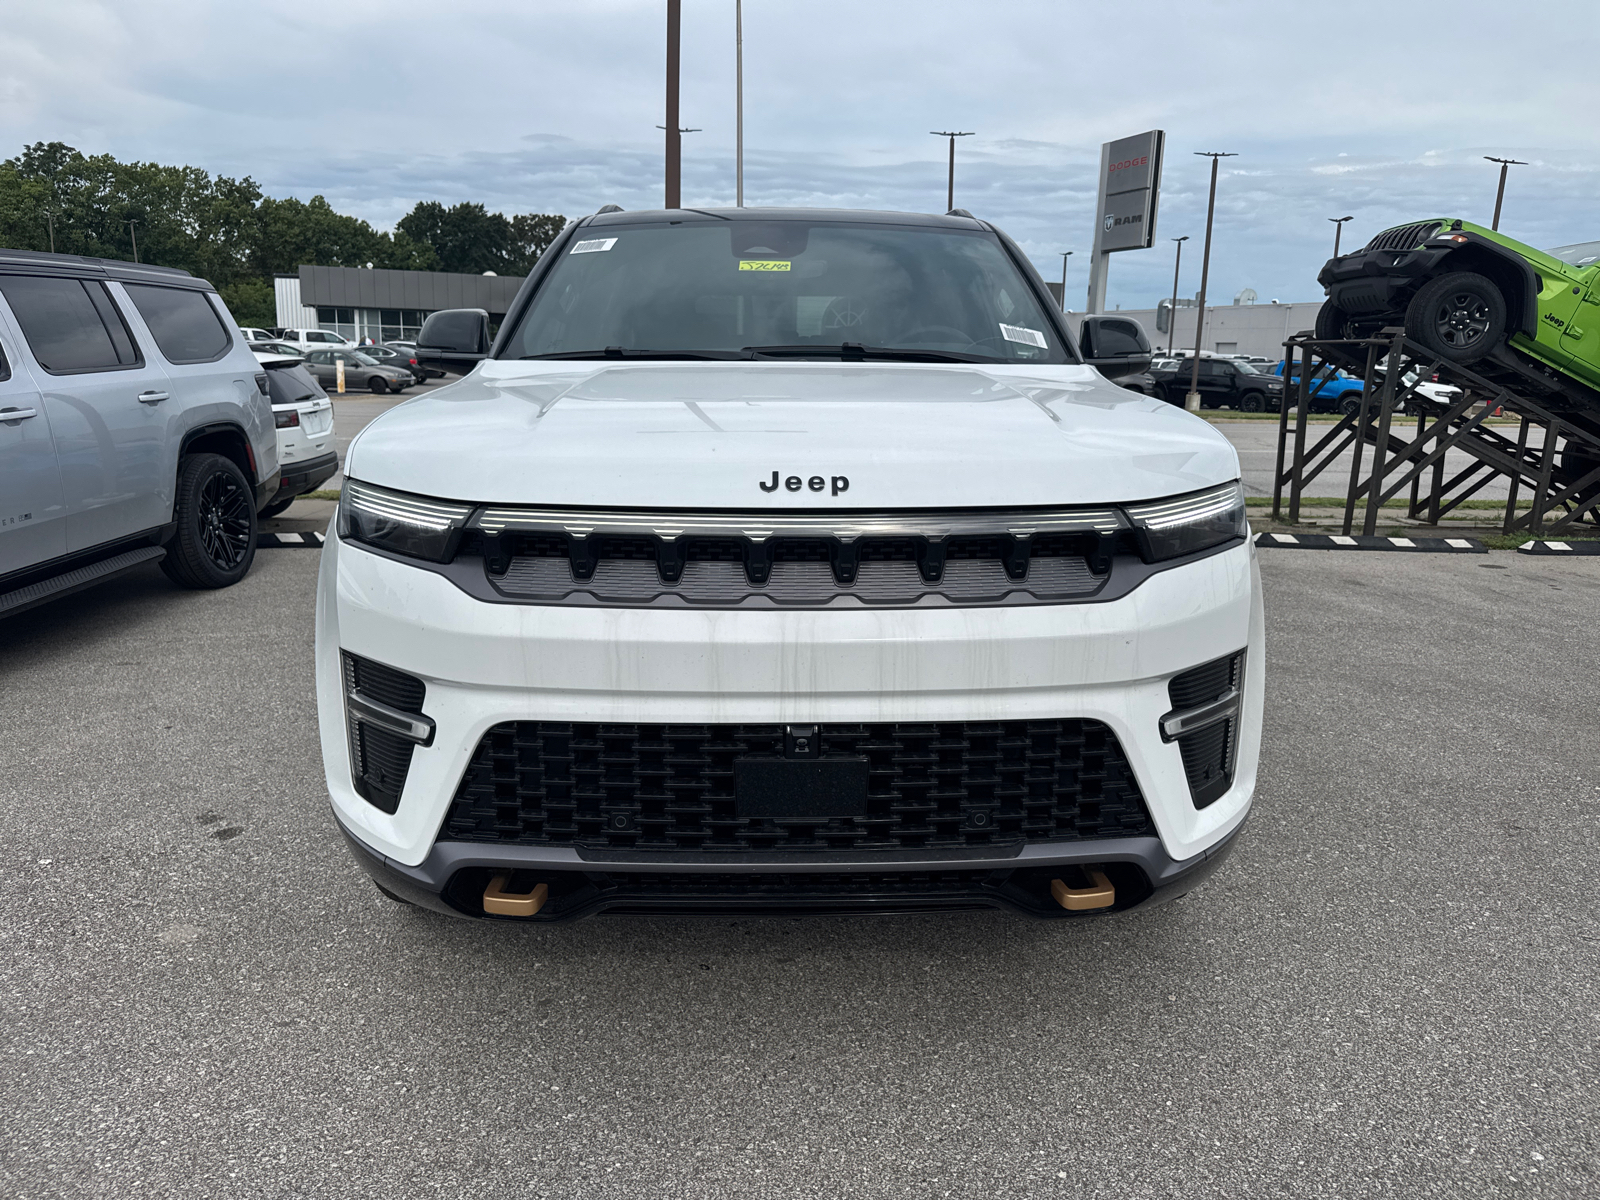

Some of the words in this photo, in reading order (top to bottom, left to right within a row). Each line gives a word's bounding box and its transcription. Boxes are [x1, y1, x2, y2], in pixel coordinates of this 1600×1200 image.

[1109, 156, 1148, 172] DODGE
[1114, 214, 1143, 226] RAM
[1544, 312, 1565, 327] Jeep
[759, 471, 850, 496] Jeep
